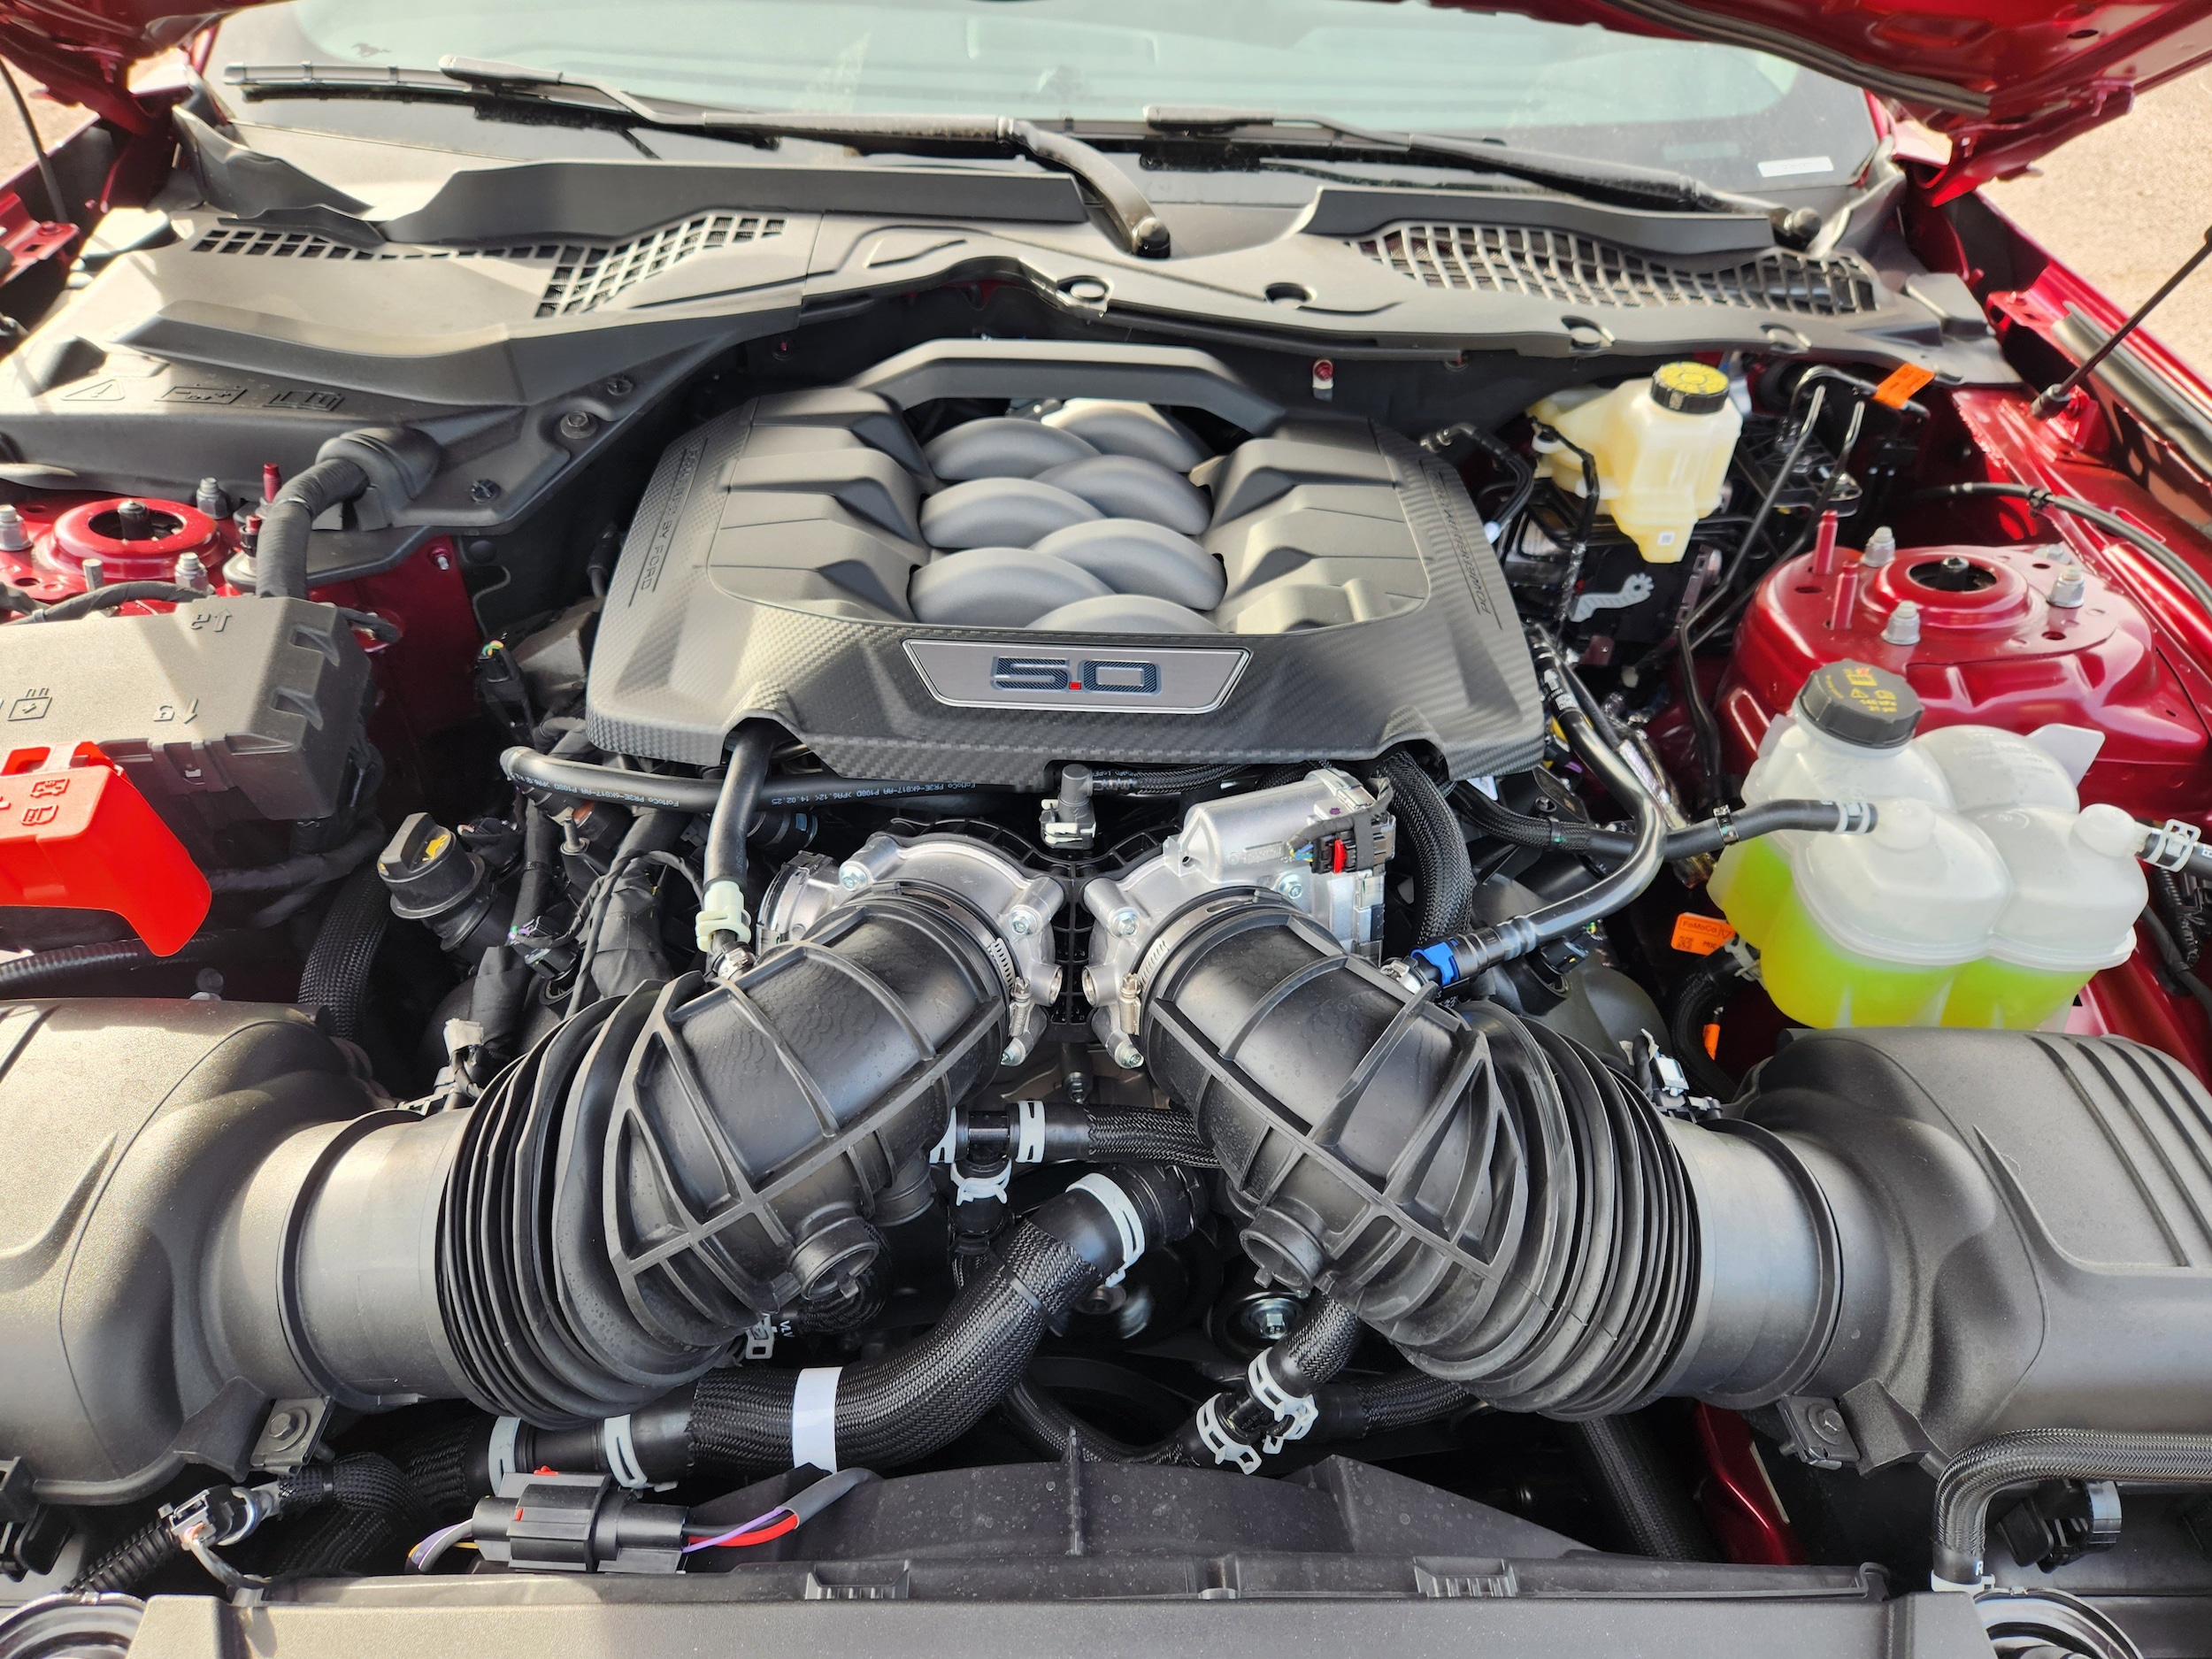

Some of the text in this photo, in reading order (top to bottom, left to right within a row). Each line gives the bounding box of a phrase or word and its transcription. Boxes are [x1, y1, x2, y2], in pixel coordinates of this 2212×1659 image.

[658, 519, 673, 540] BY
[641, 544, 664, 591] FORD
[1454, 533, 1492, 615] POWERED
[990, 656, 1164, 696] 5.0
[648, 797, 680, 808] FoMoCo
[771, 795, 810, 806] 14.02.25
[1682, 920, 1718, 933] FoMoCo
